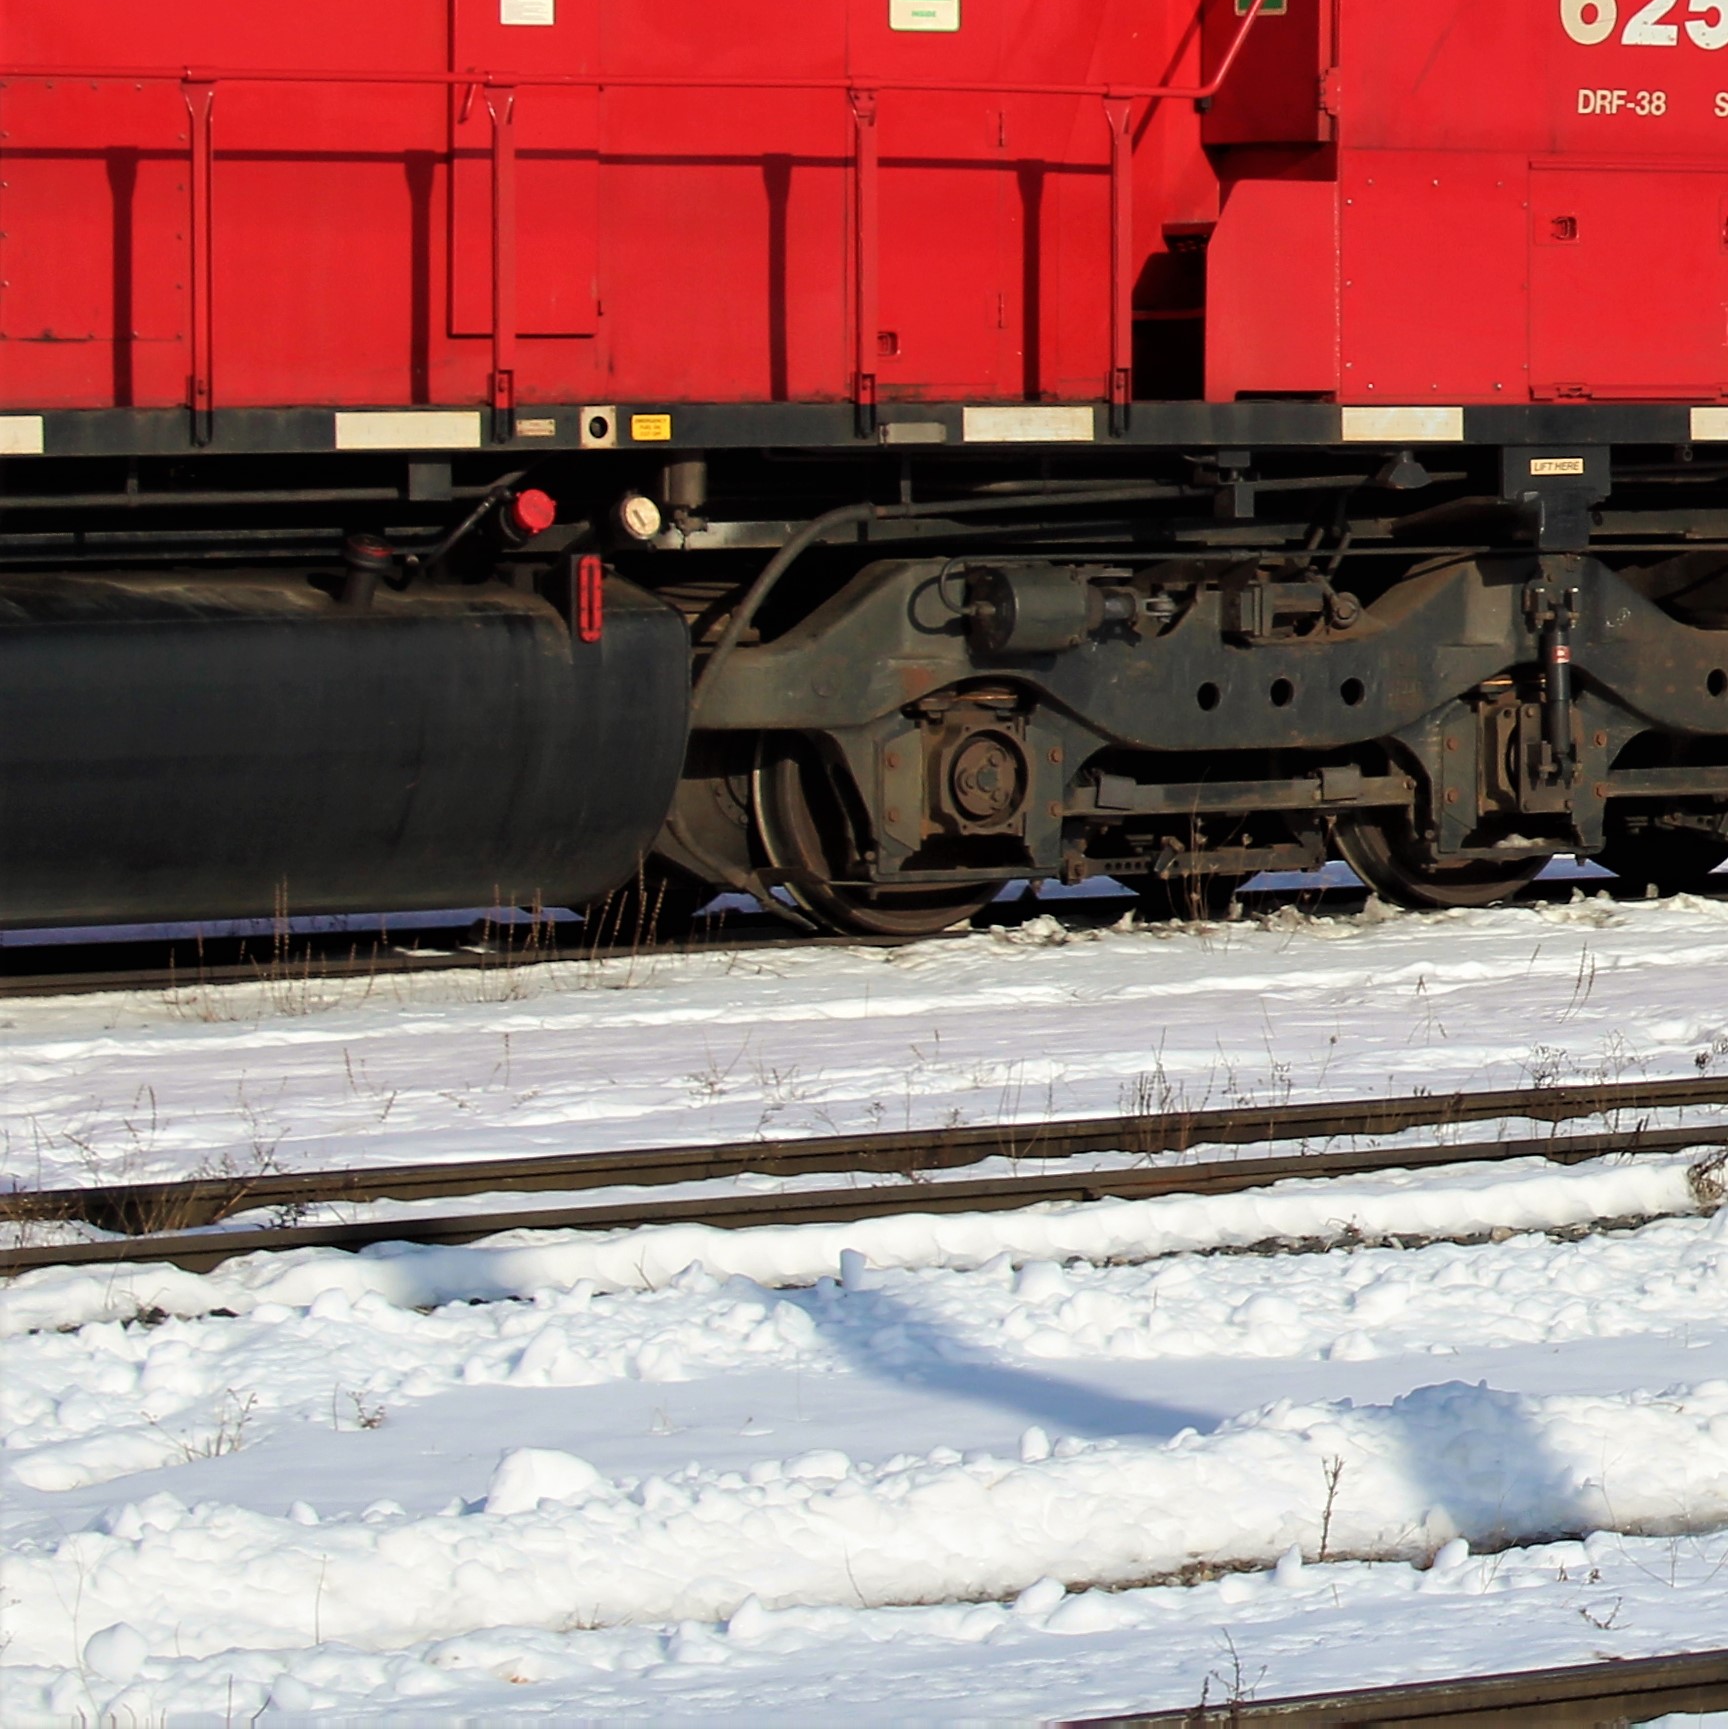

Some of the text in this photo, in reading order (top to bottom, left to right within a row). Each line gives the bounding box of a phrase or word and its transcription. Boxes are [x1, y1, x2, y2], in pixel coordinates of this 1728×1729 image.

[1577, 88, 1667, 116] DRF-38
[1534, 460, 1580, 472] LIFT HERE
